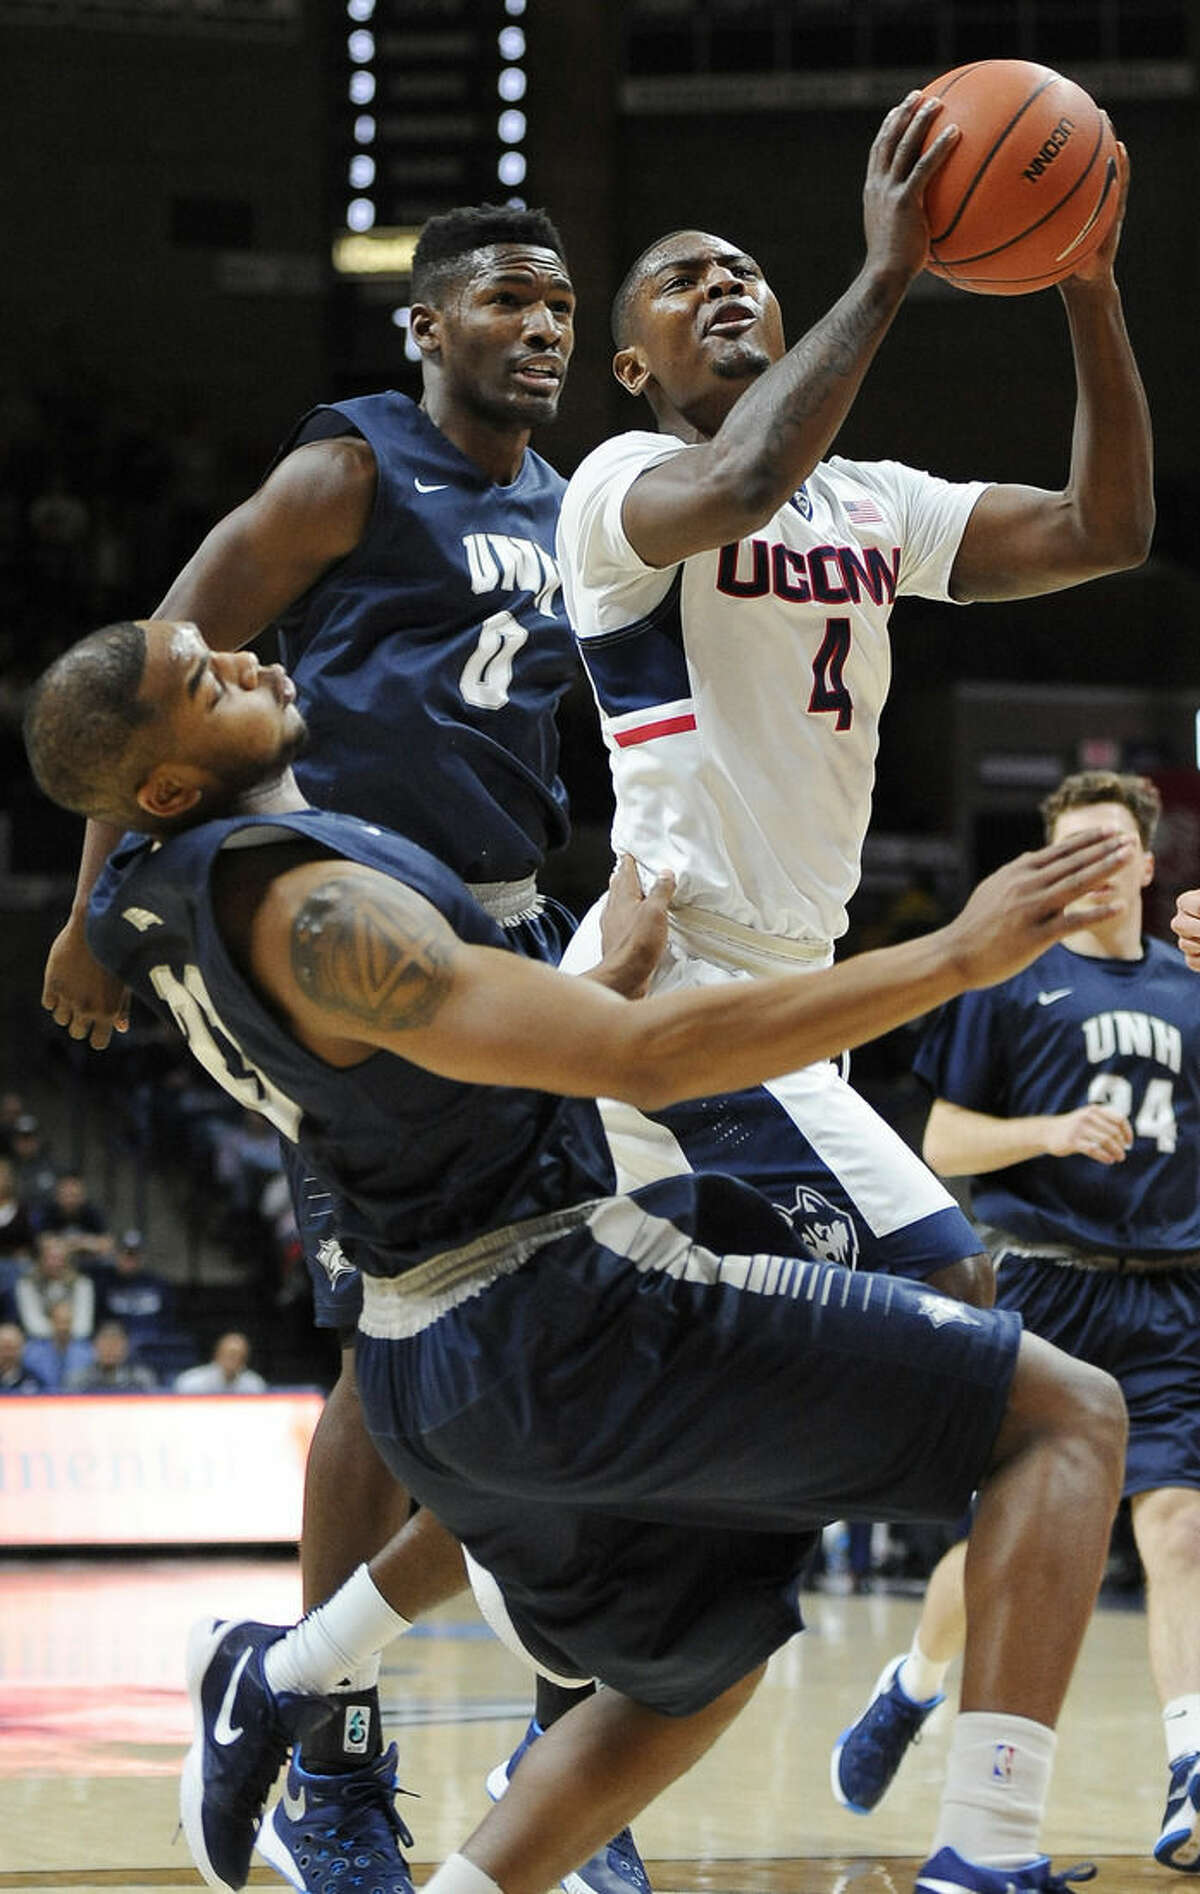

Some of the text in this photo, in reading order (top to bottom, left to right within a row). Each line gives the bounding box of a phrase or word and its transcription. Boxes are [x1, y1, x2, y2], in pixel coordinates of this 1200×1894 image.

[1022, 117, 1076, 184] UCONN
[716, 539, 902, 606] UCONN
[459, 610, 529, 710] 0
[807, 617, 853, 731] 4
[1082, 1010, 1182, 1075] UNH
